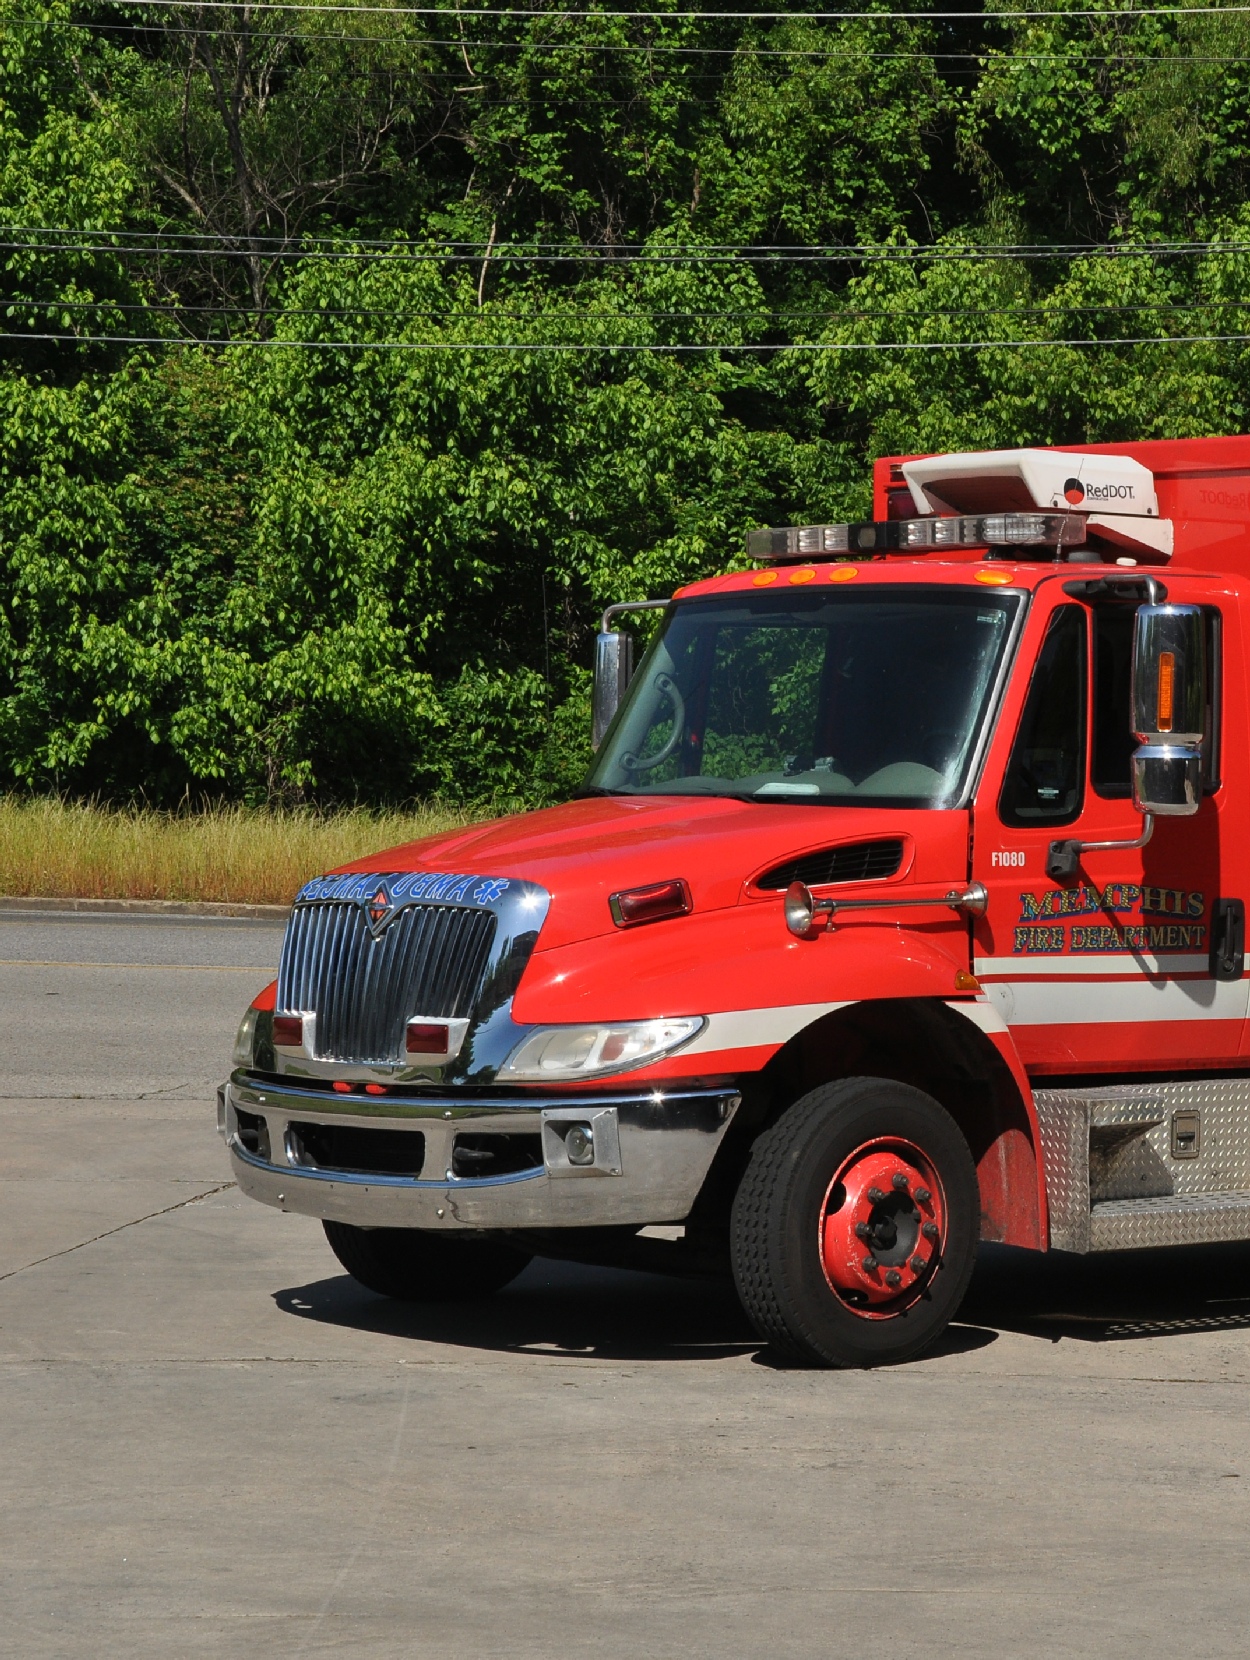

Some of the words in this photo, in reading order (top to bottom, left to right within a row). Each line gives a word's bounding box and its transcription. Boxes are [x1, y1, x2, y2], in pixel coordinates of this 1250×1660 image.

[1086, 483, 1134, 499] RedDOT
[991, 851, 1025, 867] F1080
[1018, 883, 1206, 922] MEMPHIS
[1013, 926, 1065, 953] FIRE
[1070, 924, 1206, 952] DEPARTMENT
